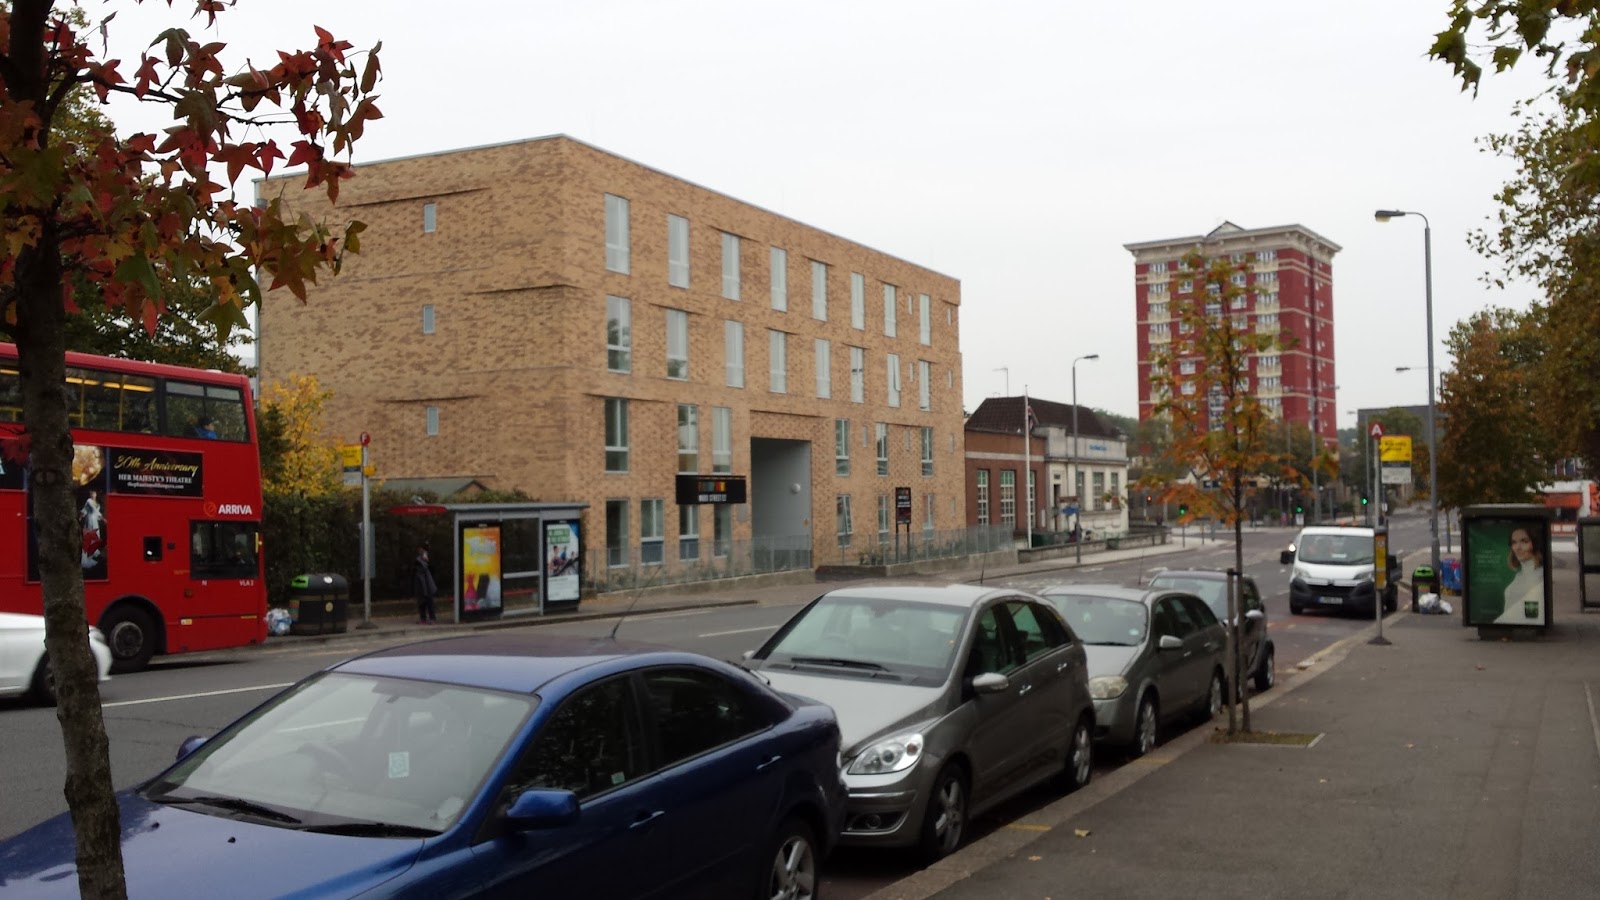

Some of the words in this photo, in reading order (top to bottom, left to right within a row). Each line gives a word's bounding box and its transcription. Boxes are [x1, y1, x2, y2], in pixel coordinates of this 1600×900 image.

[1371, 423, 1382, 436] A
[114, 455, 141, 469] 30th
[142, 457, 199, 478] Anniversary
[118, 473, 132, 481] HER
[133, 474, 165, 482] MAJESTY'S
[165, 476, 193, 484] THEATRE
[218, 504, 253, 515] ARRIVA
